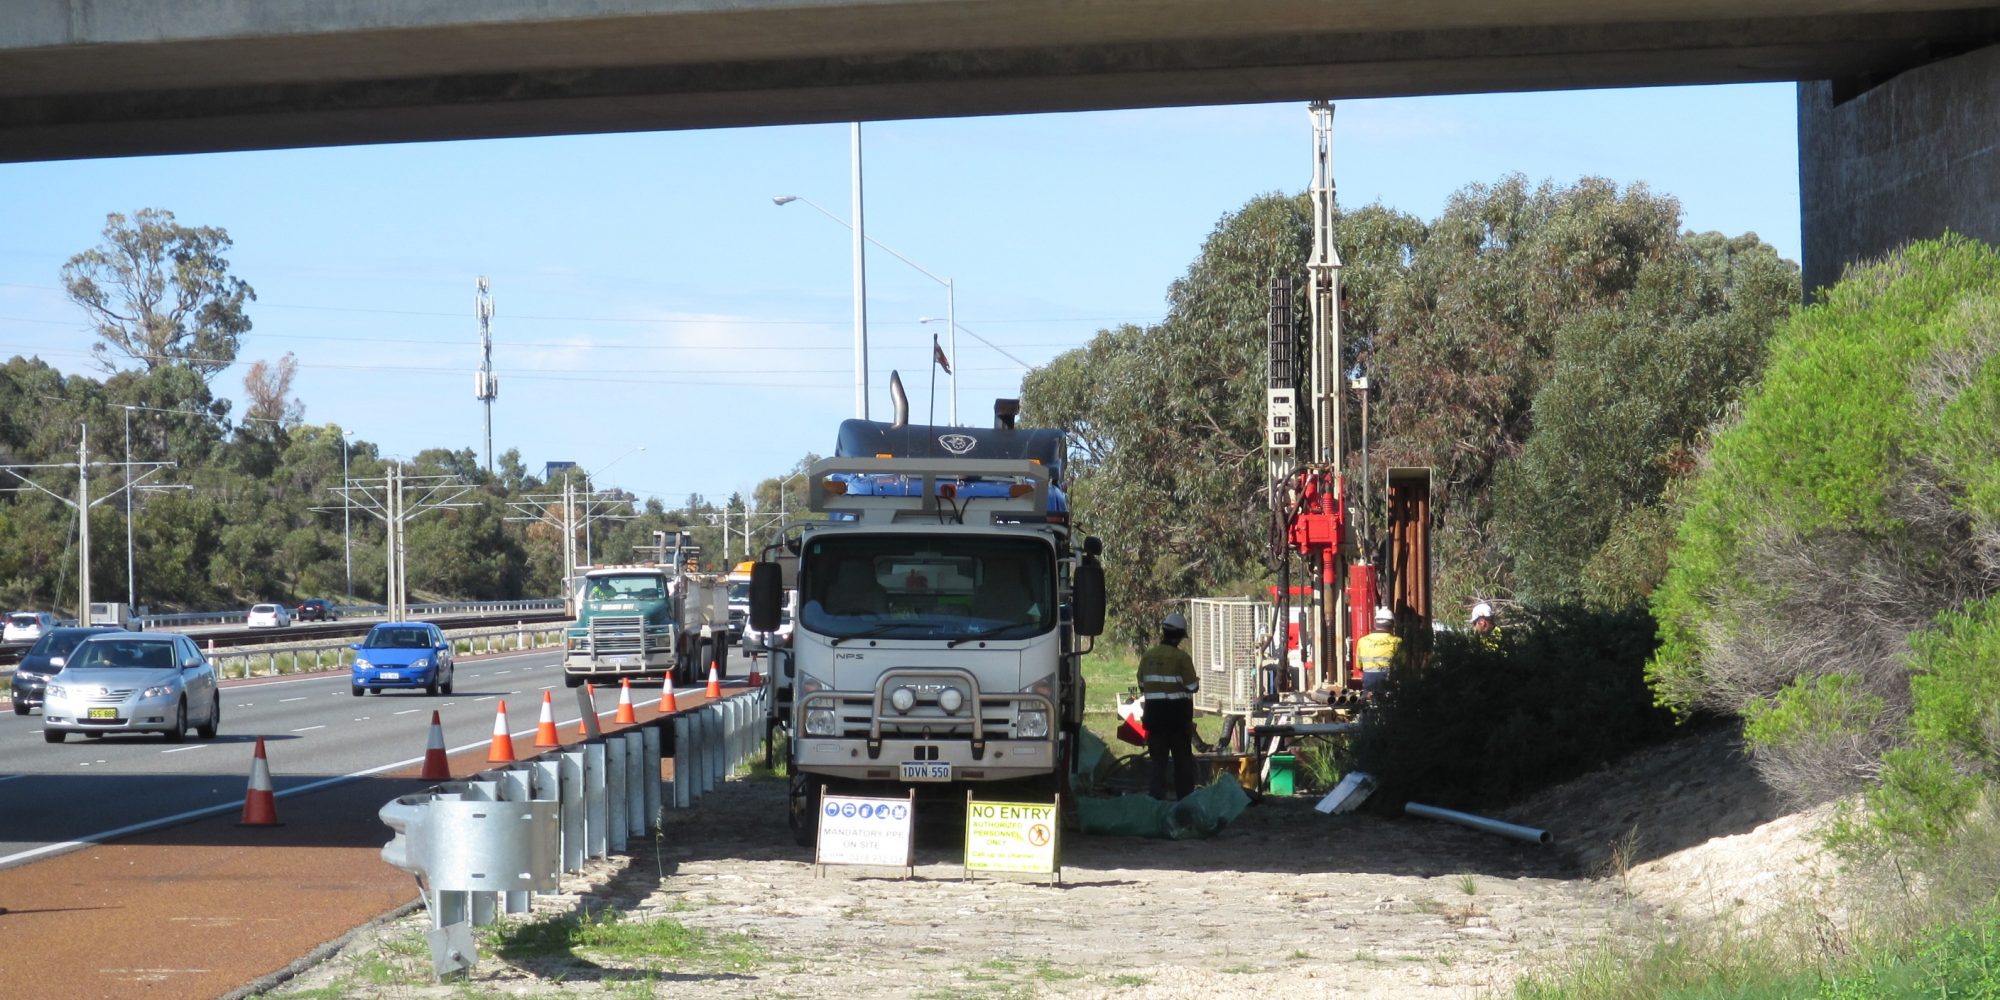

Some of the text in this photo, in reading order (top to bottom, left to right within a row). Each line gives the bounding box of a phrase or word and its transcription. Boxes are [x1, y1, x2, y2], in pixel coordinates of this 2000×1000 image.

[904, 766, 949, 778] 1DVN 550
[973, 806, 1051, 820] NO ENTRY
[824, 828, 904, 839] MANDATORY PPE
[842, 840, 880, 849] ON SITE
